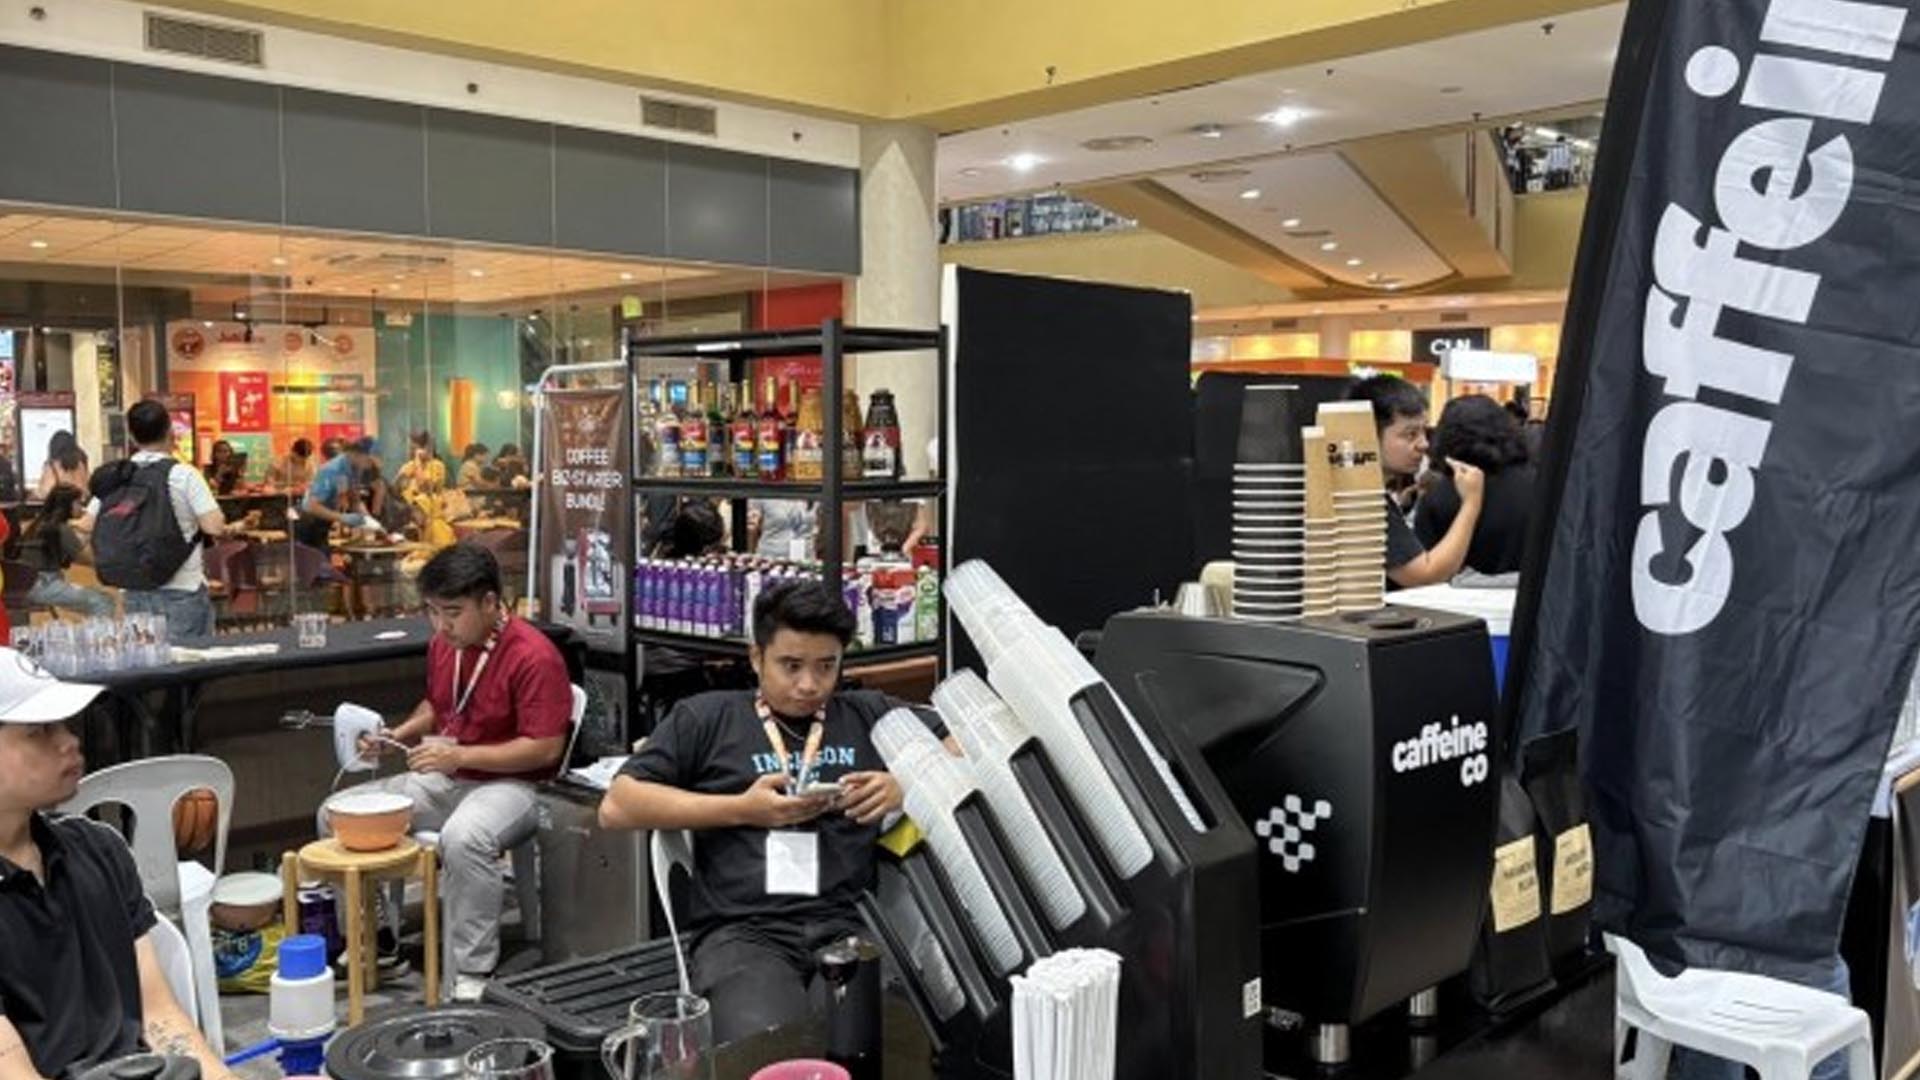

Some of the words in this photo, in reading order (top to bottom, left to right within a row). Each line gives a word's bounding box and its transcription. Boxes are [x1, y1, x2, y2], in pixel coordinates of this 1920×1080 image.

[565, 447, 609, 465] COFFEE
[1392, 714, 1488, 773] caffeine
[1460, 753, 1488, 787] co
